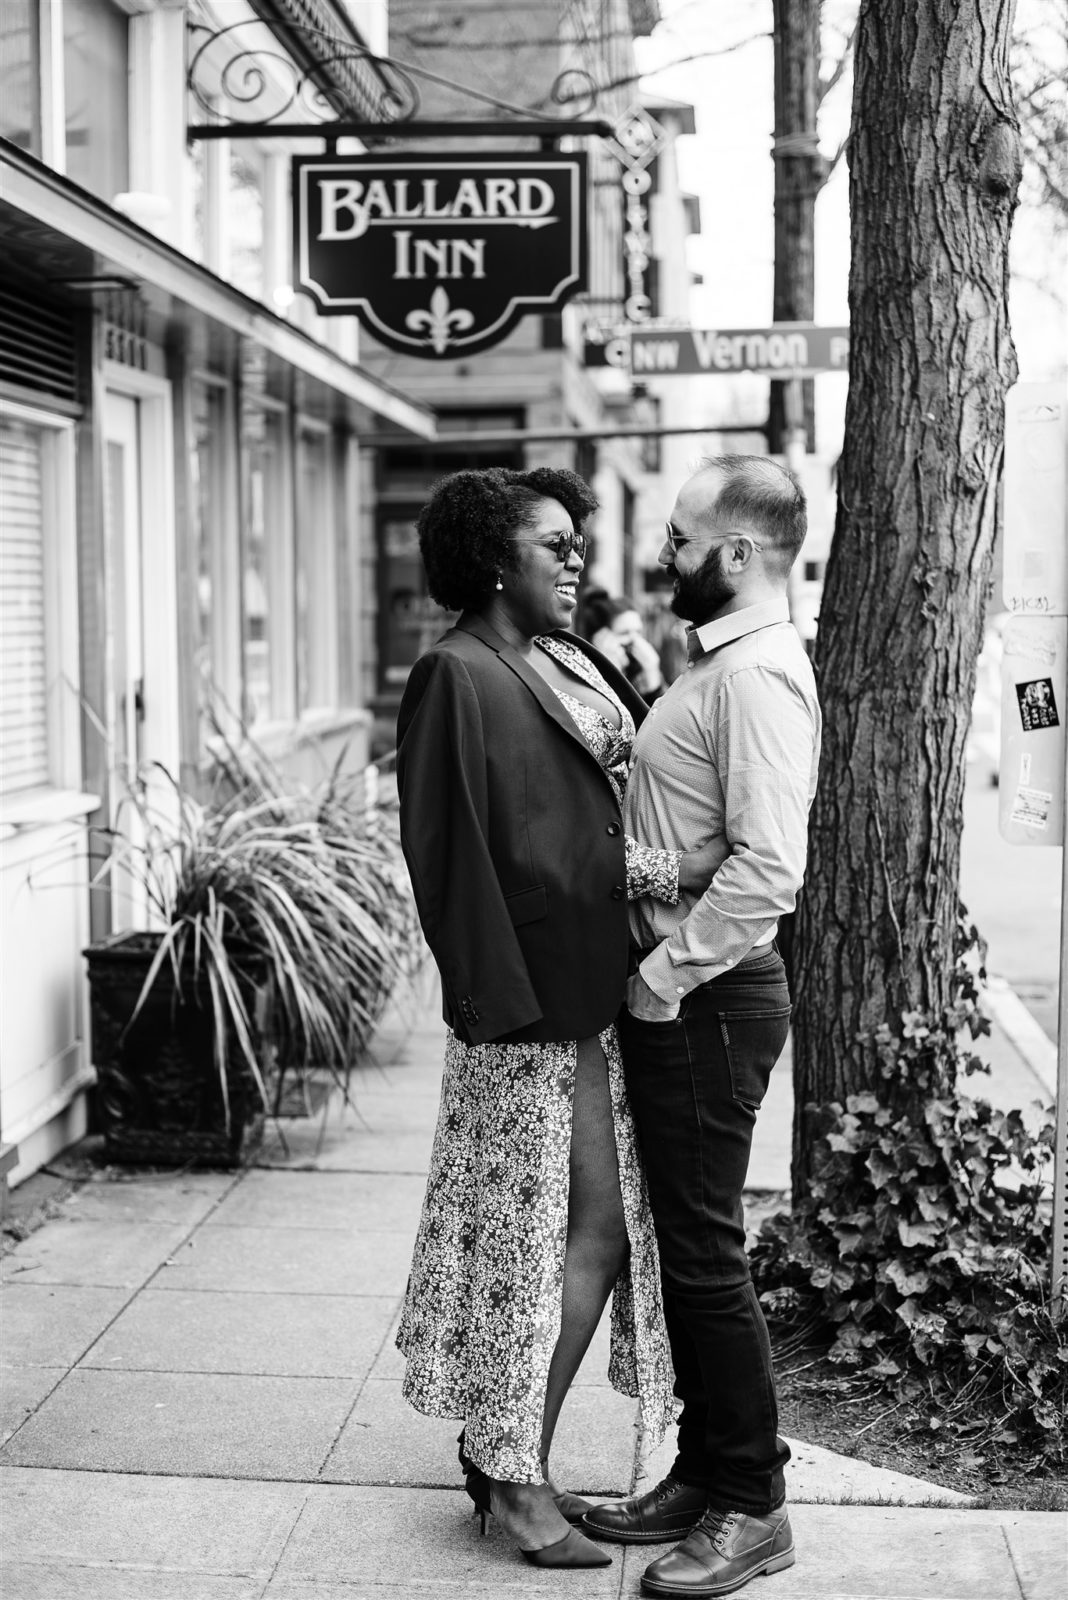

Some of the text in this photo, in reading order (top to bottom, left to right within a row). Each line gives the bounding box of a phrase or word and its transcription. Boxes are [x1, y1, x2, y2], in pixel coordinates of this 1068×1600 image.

[316, 177, 556, 242] BALLARD
[392, 230, 487, 280] INN
[632, 340, 680, 371] NW
[690, 330, 809, 370] Vernon
[829, 336, 850, 367] P
